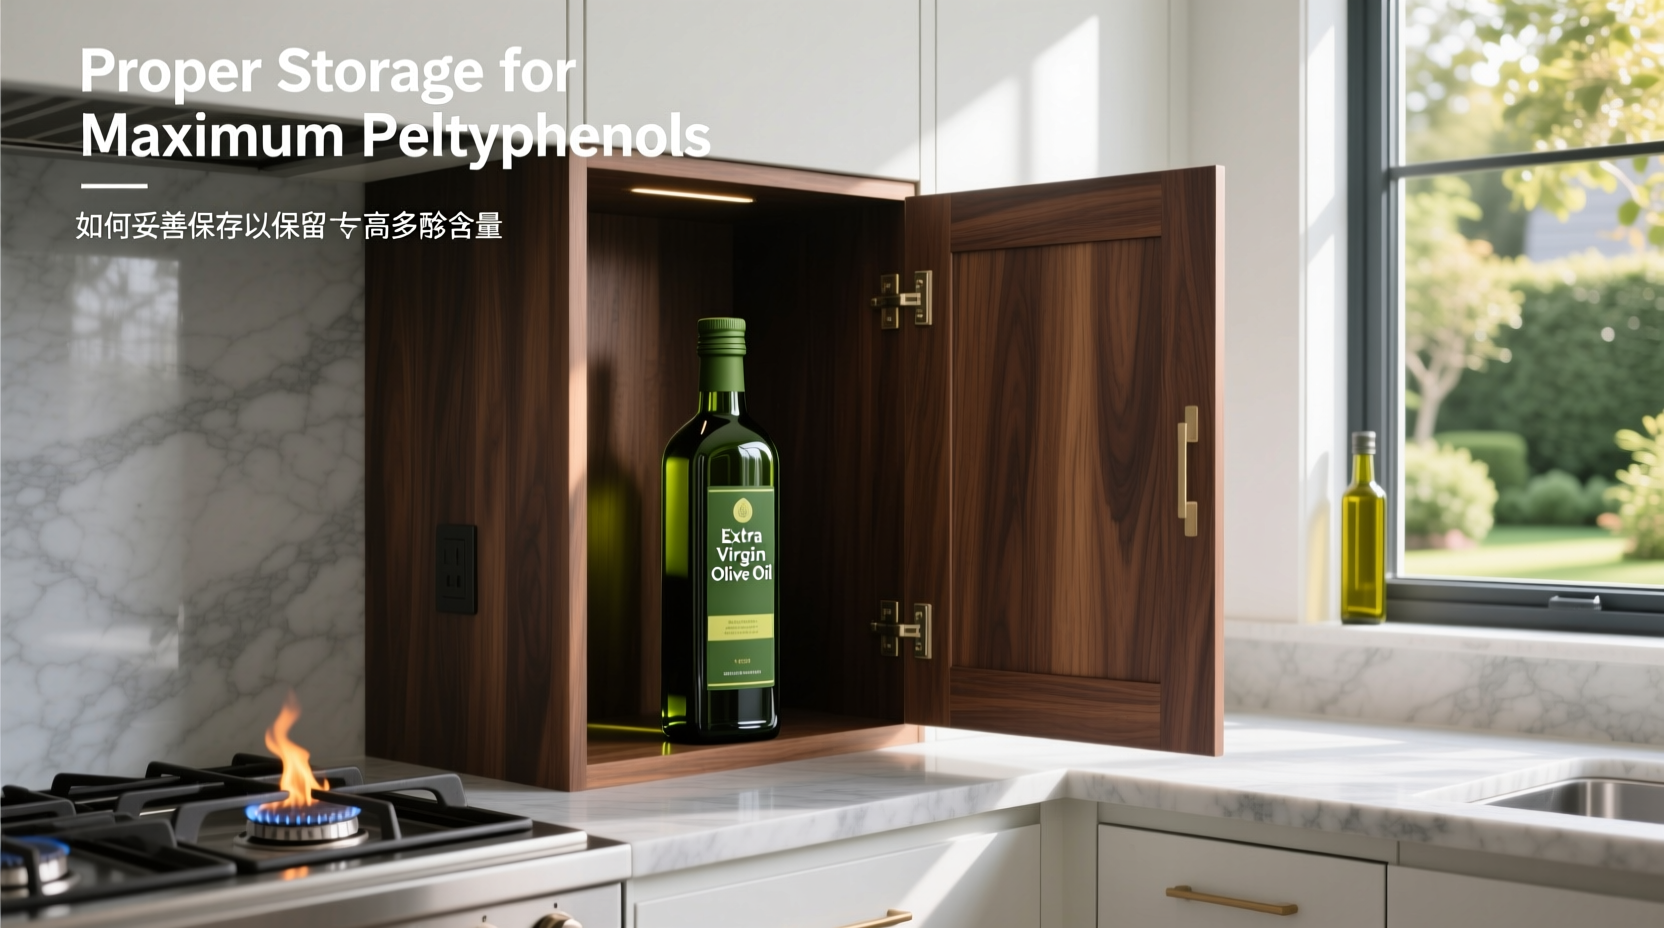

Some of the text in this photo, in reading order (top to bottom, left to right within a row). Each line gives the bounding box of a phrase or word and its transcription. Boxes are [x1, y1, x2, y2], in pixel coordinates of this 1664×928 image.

[721, 527, 763, 544] Extra
[716, 546, 766, 567] Virgin
[711, 563, 773, 582] Olive Oil
